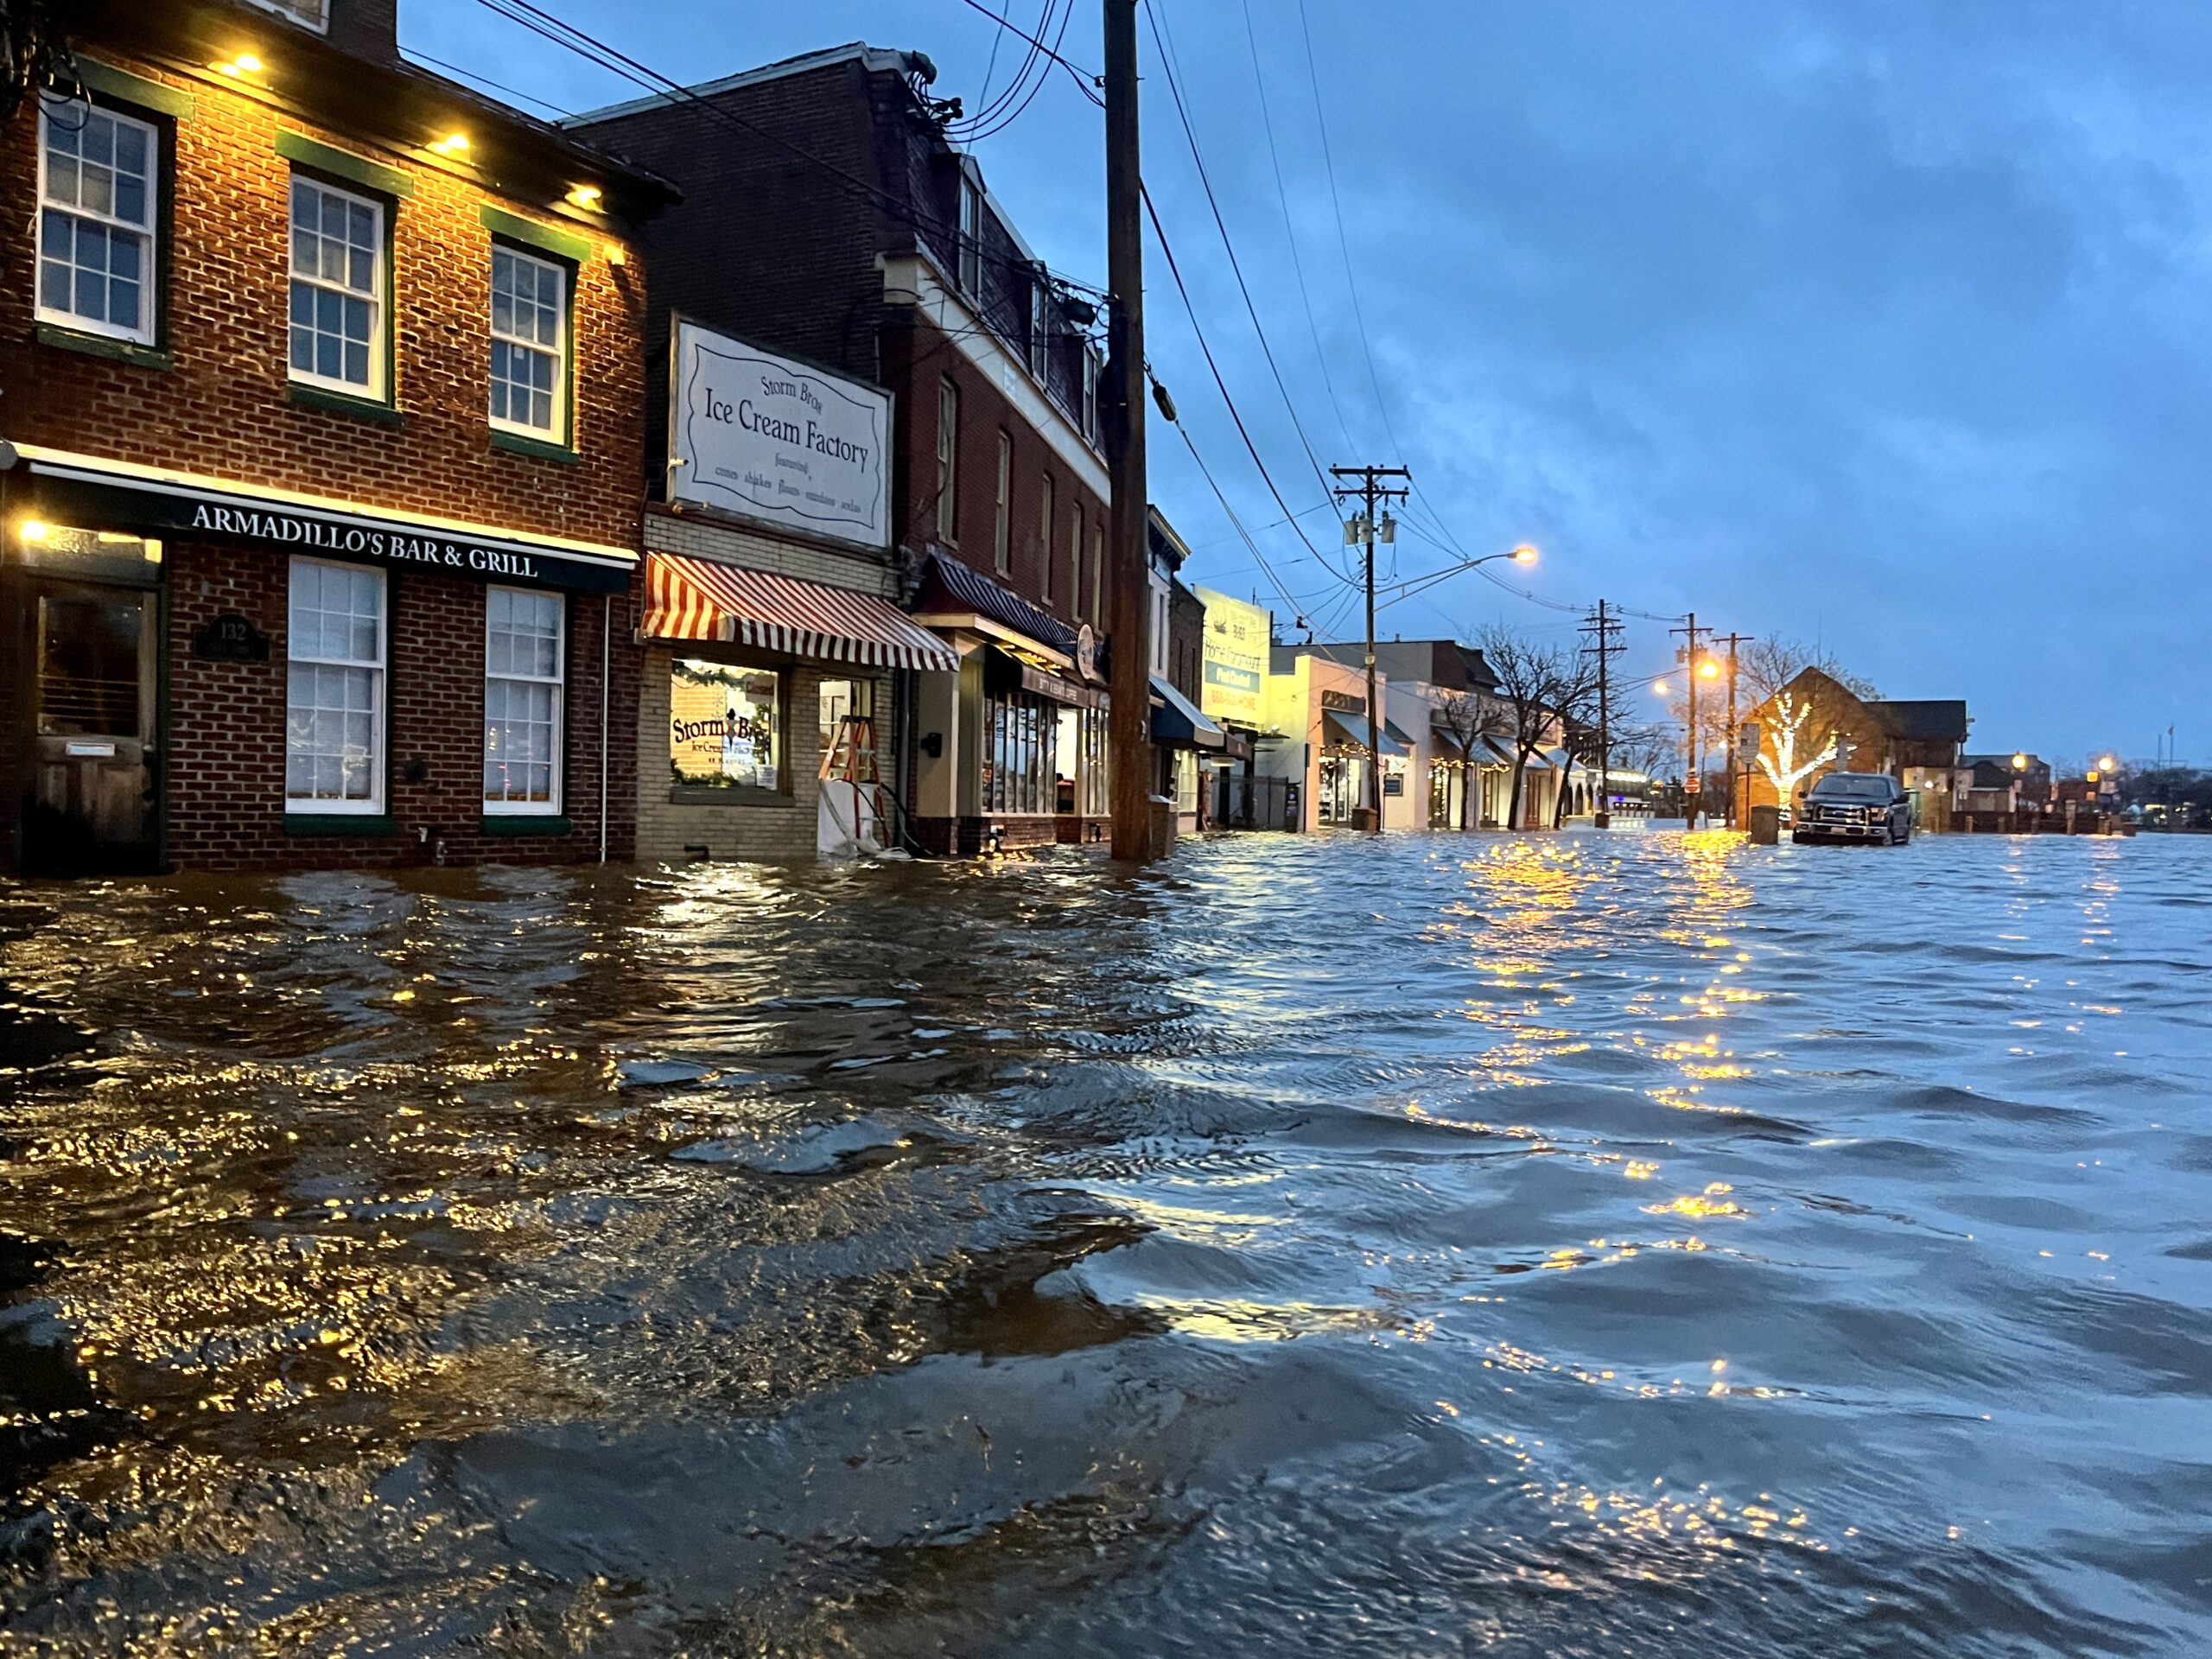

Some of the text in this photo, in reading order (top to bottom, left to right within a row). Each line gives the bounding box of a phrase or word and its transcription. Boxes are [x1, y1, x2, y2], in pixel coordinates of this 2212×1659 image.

[761, 375, 796, 397] Storm
[705, 387, 868, 474] Ice Cream Factory
[192, 505, 538, 578] ARMADILLO'S BAR & GRILL
[221, 622, 247, 641] 132
[673, 718, 725, 744] Storm
